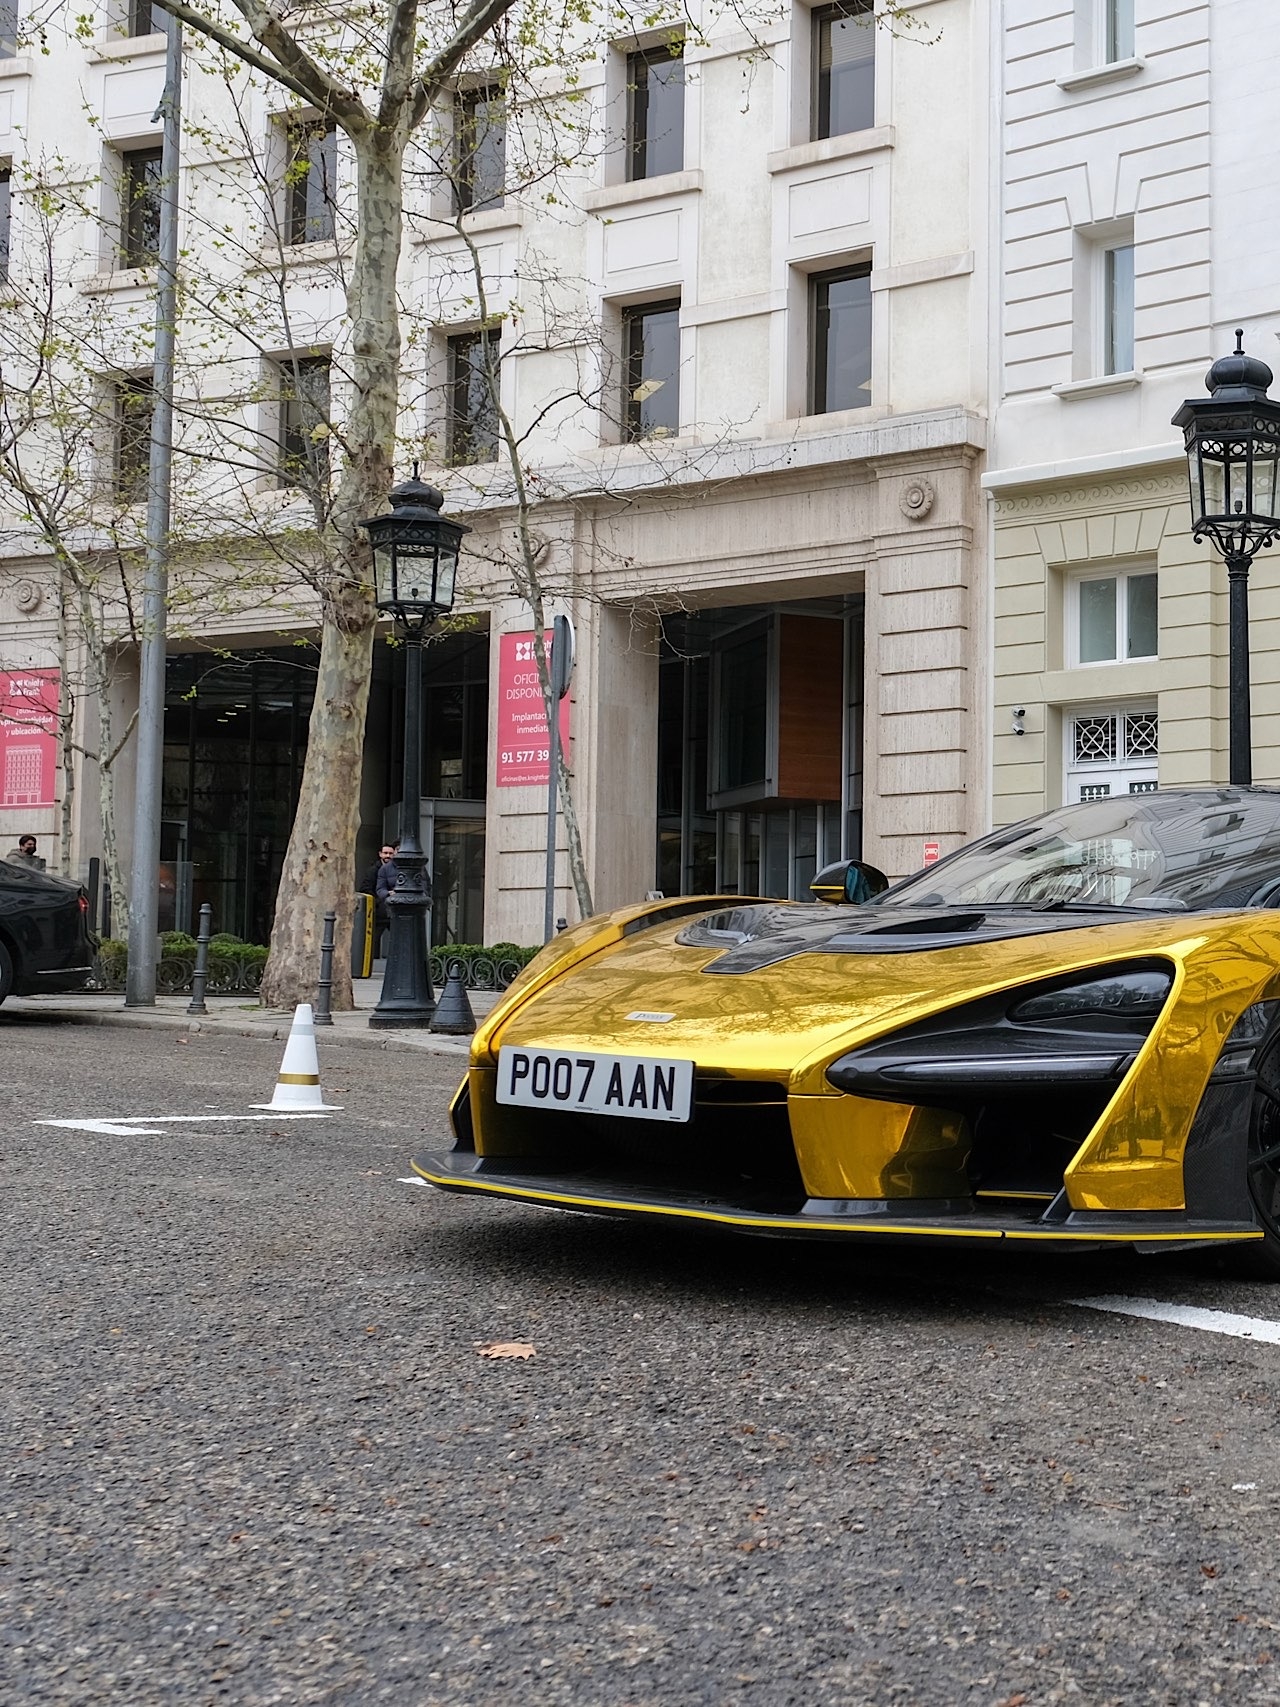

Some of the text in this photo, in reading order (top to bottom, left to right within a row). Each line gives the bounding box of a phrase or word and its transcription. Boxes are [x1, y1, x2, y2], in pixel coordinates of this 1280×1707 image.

[513, 672, 540, 685] OFICI
[506, 687, 543, 700] DISPONI
[511, 712, 547, 723] Implantaci
[501, 749, 550, 764] 91 577 39
[604, 1062, 676, 1111] AAN
